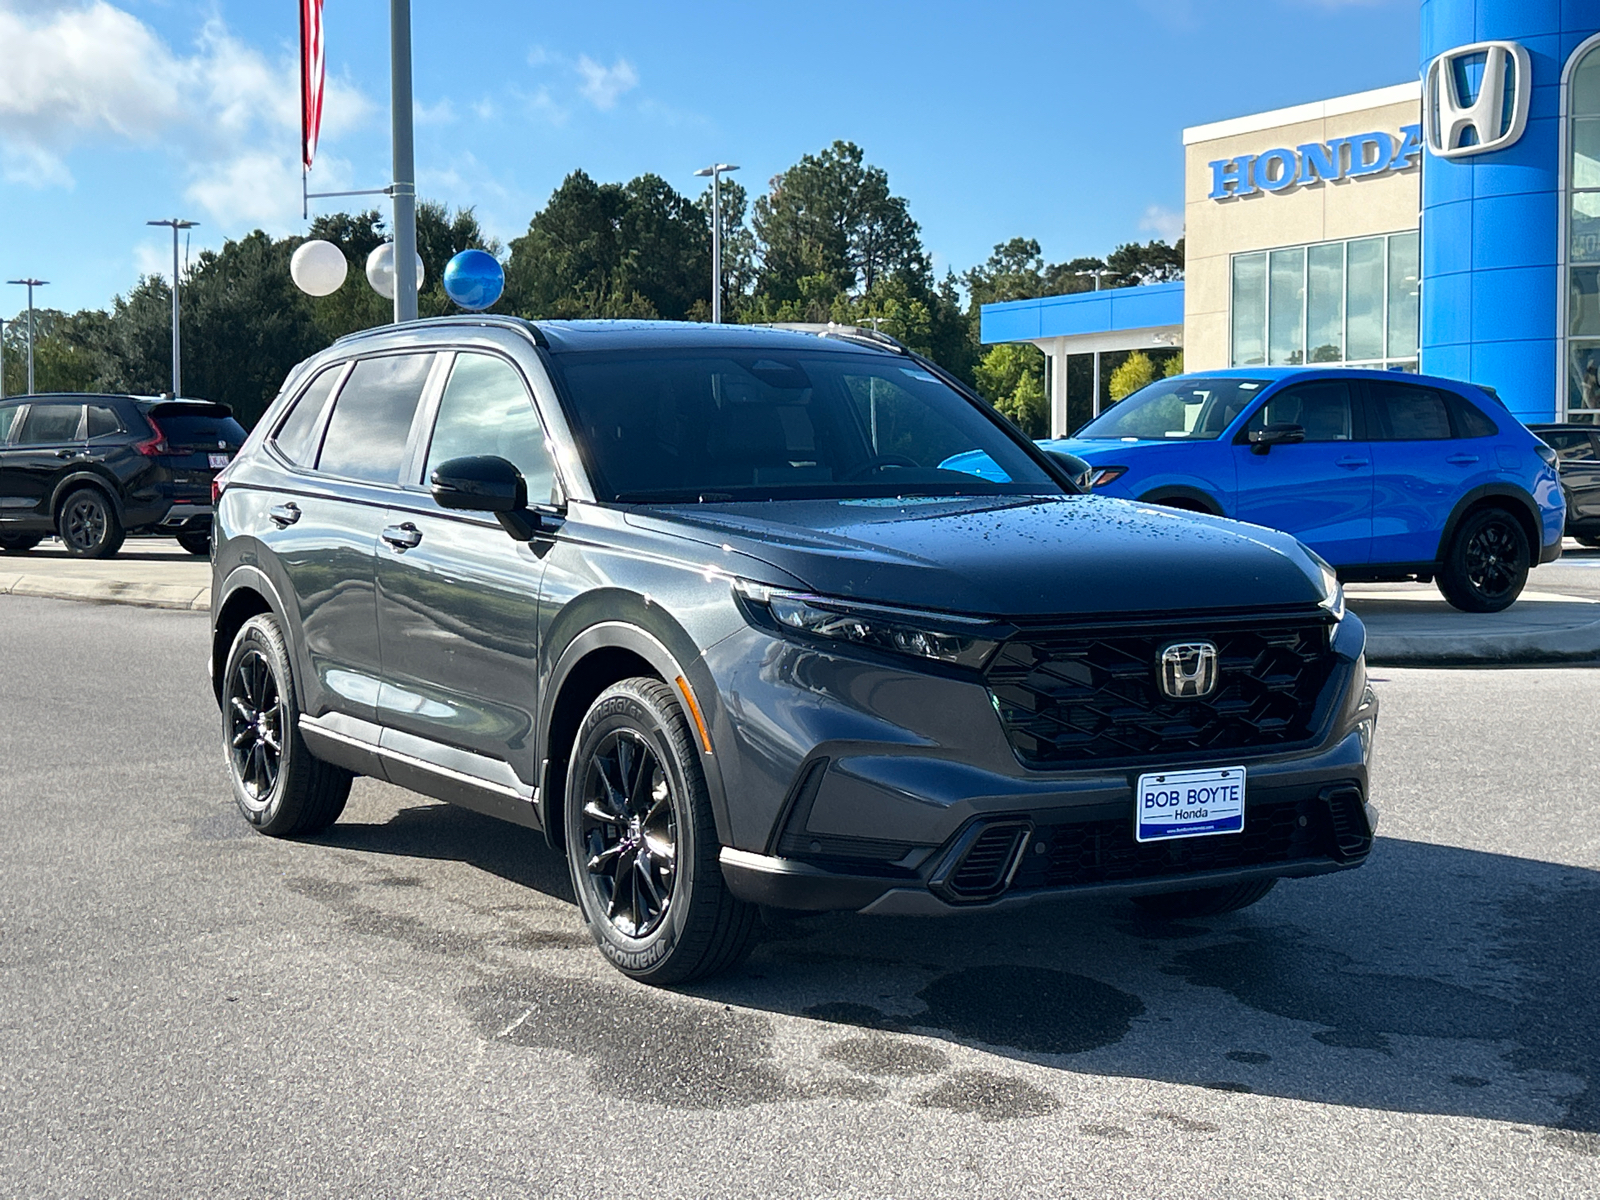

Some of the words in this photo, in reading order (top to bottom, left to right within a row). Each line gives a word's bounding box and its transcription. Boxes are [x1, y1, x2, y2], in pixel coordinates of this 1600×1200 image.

[1208, 124, 1420, 200] HONDA
[1145, 791, 1180, 808] BOB
[1187, 785, 1239, 805] BOYTE
[1175, 808, 1208, 820] Honda
